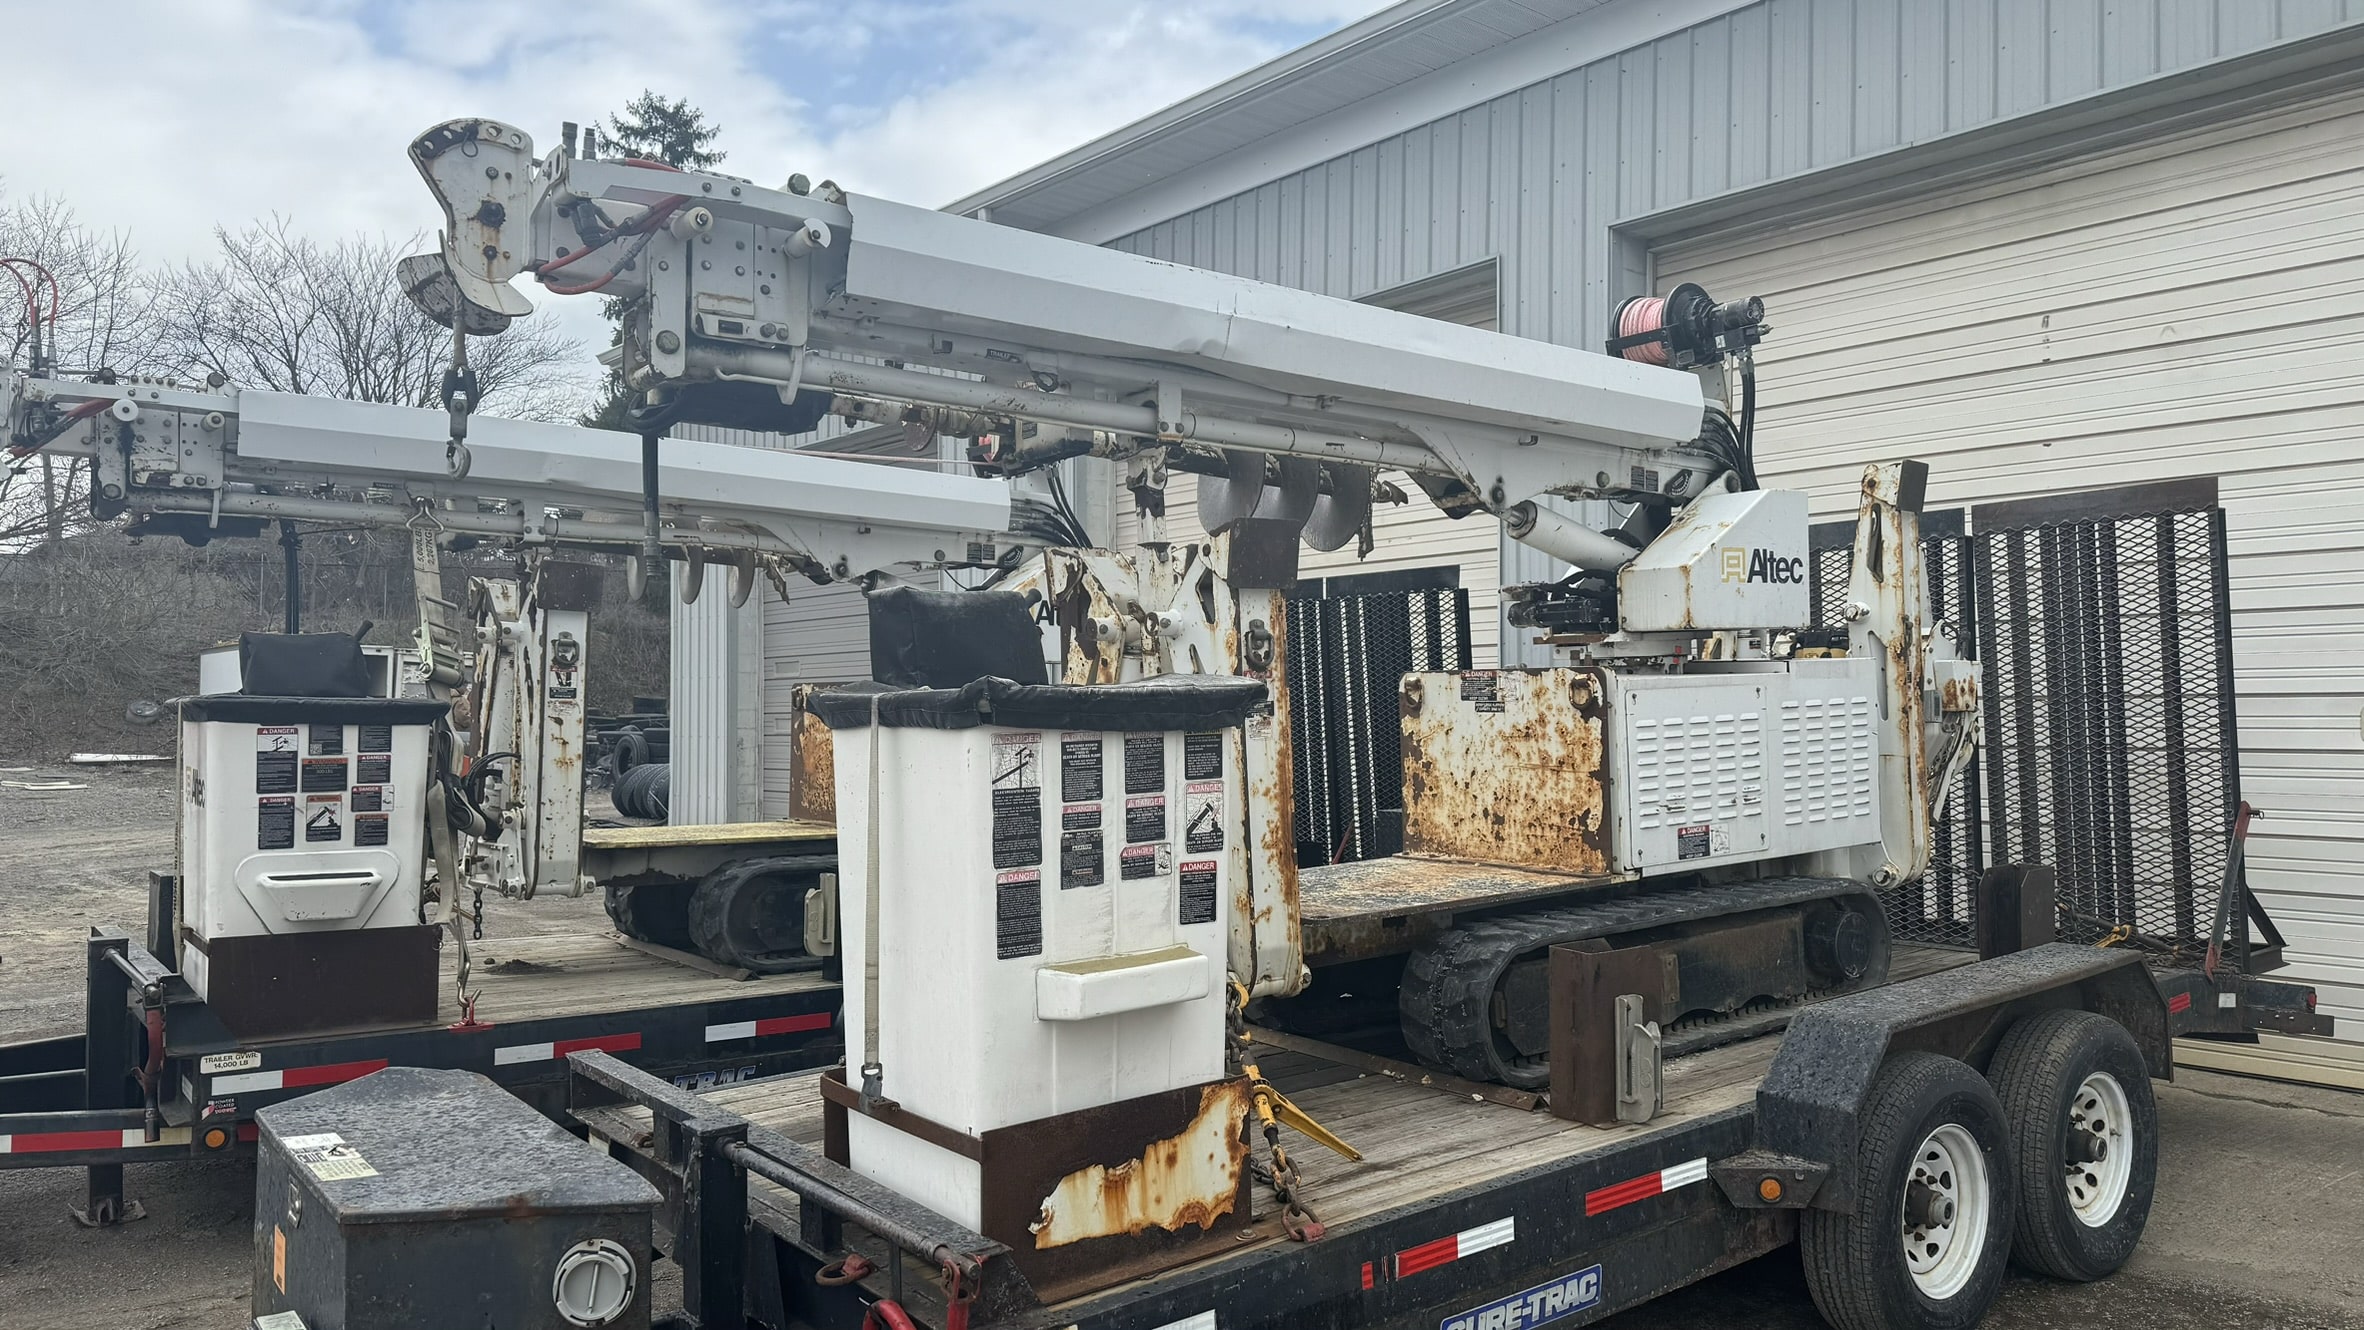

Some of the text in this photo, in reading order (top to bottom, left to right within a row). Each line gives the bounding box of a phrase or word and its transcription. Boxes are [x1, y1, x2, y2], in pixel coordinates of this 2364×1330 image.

[1746, 548, 1804, 584] Altec
[1005, 735, 1041, 744] DANGER
[1135, 797, 1164, 807] DANGER
[1073, 805, 1098, 813] DANGER
[1128, 846, 1154, 856] DANGER
[1188, 862, 1215, 871] DANGER
[204, 1055, 233, 1064] TRAILER
[214, 1061, 237, 1069] 14,000
